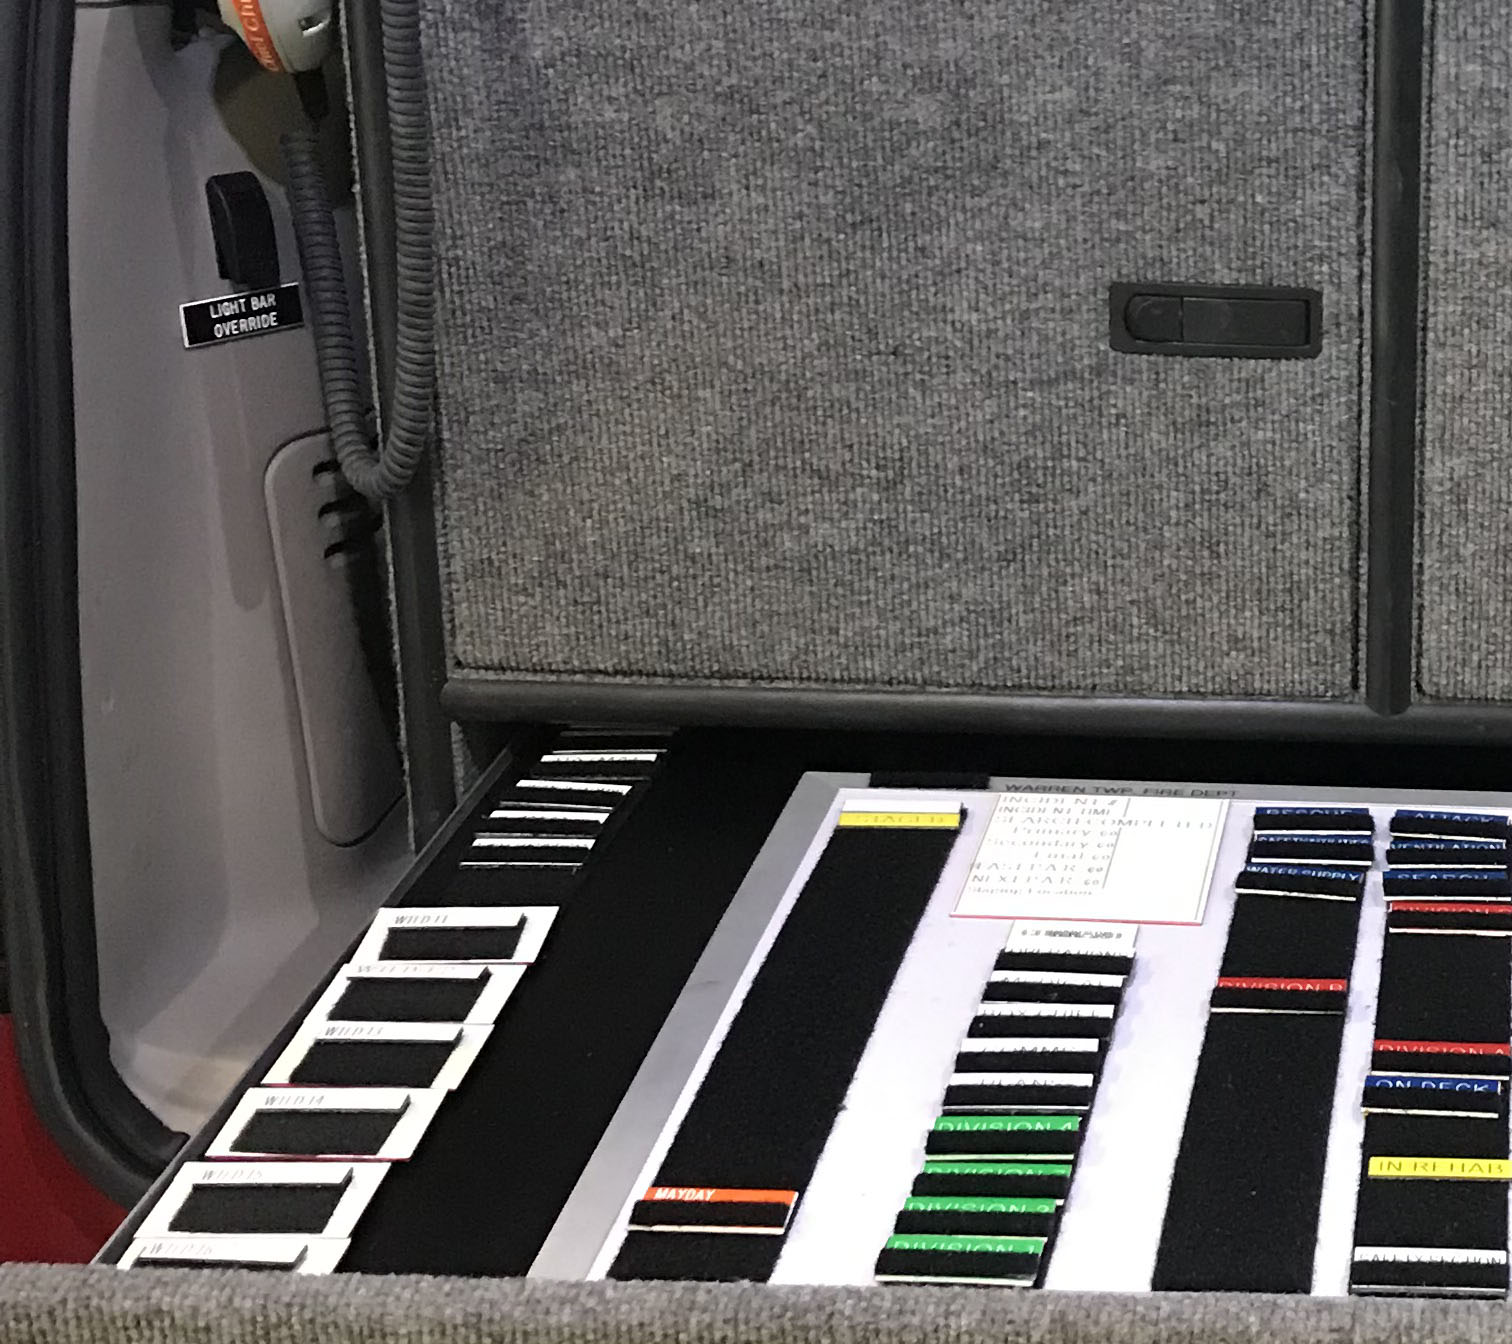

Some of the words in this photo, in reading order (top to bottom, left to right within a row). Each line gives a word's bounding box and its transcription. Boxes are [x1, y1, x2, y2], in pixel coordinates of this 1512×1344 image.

[209, 298, 247, 319] LIGHT
[250, 293, 277, 311] BAR
[213, 312, 278, 338] OVERRIDE
[1005, 783, 1087, 794] WARREN
[1144, 787, 1186, 797] FIRE
[1190, 788, 1240, 798] DEPT
[1374, 1078, 1412, 1089] ON
[652, 1187, 718, 1201] MAYDAY
